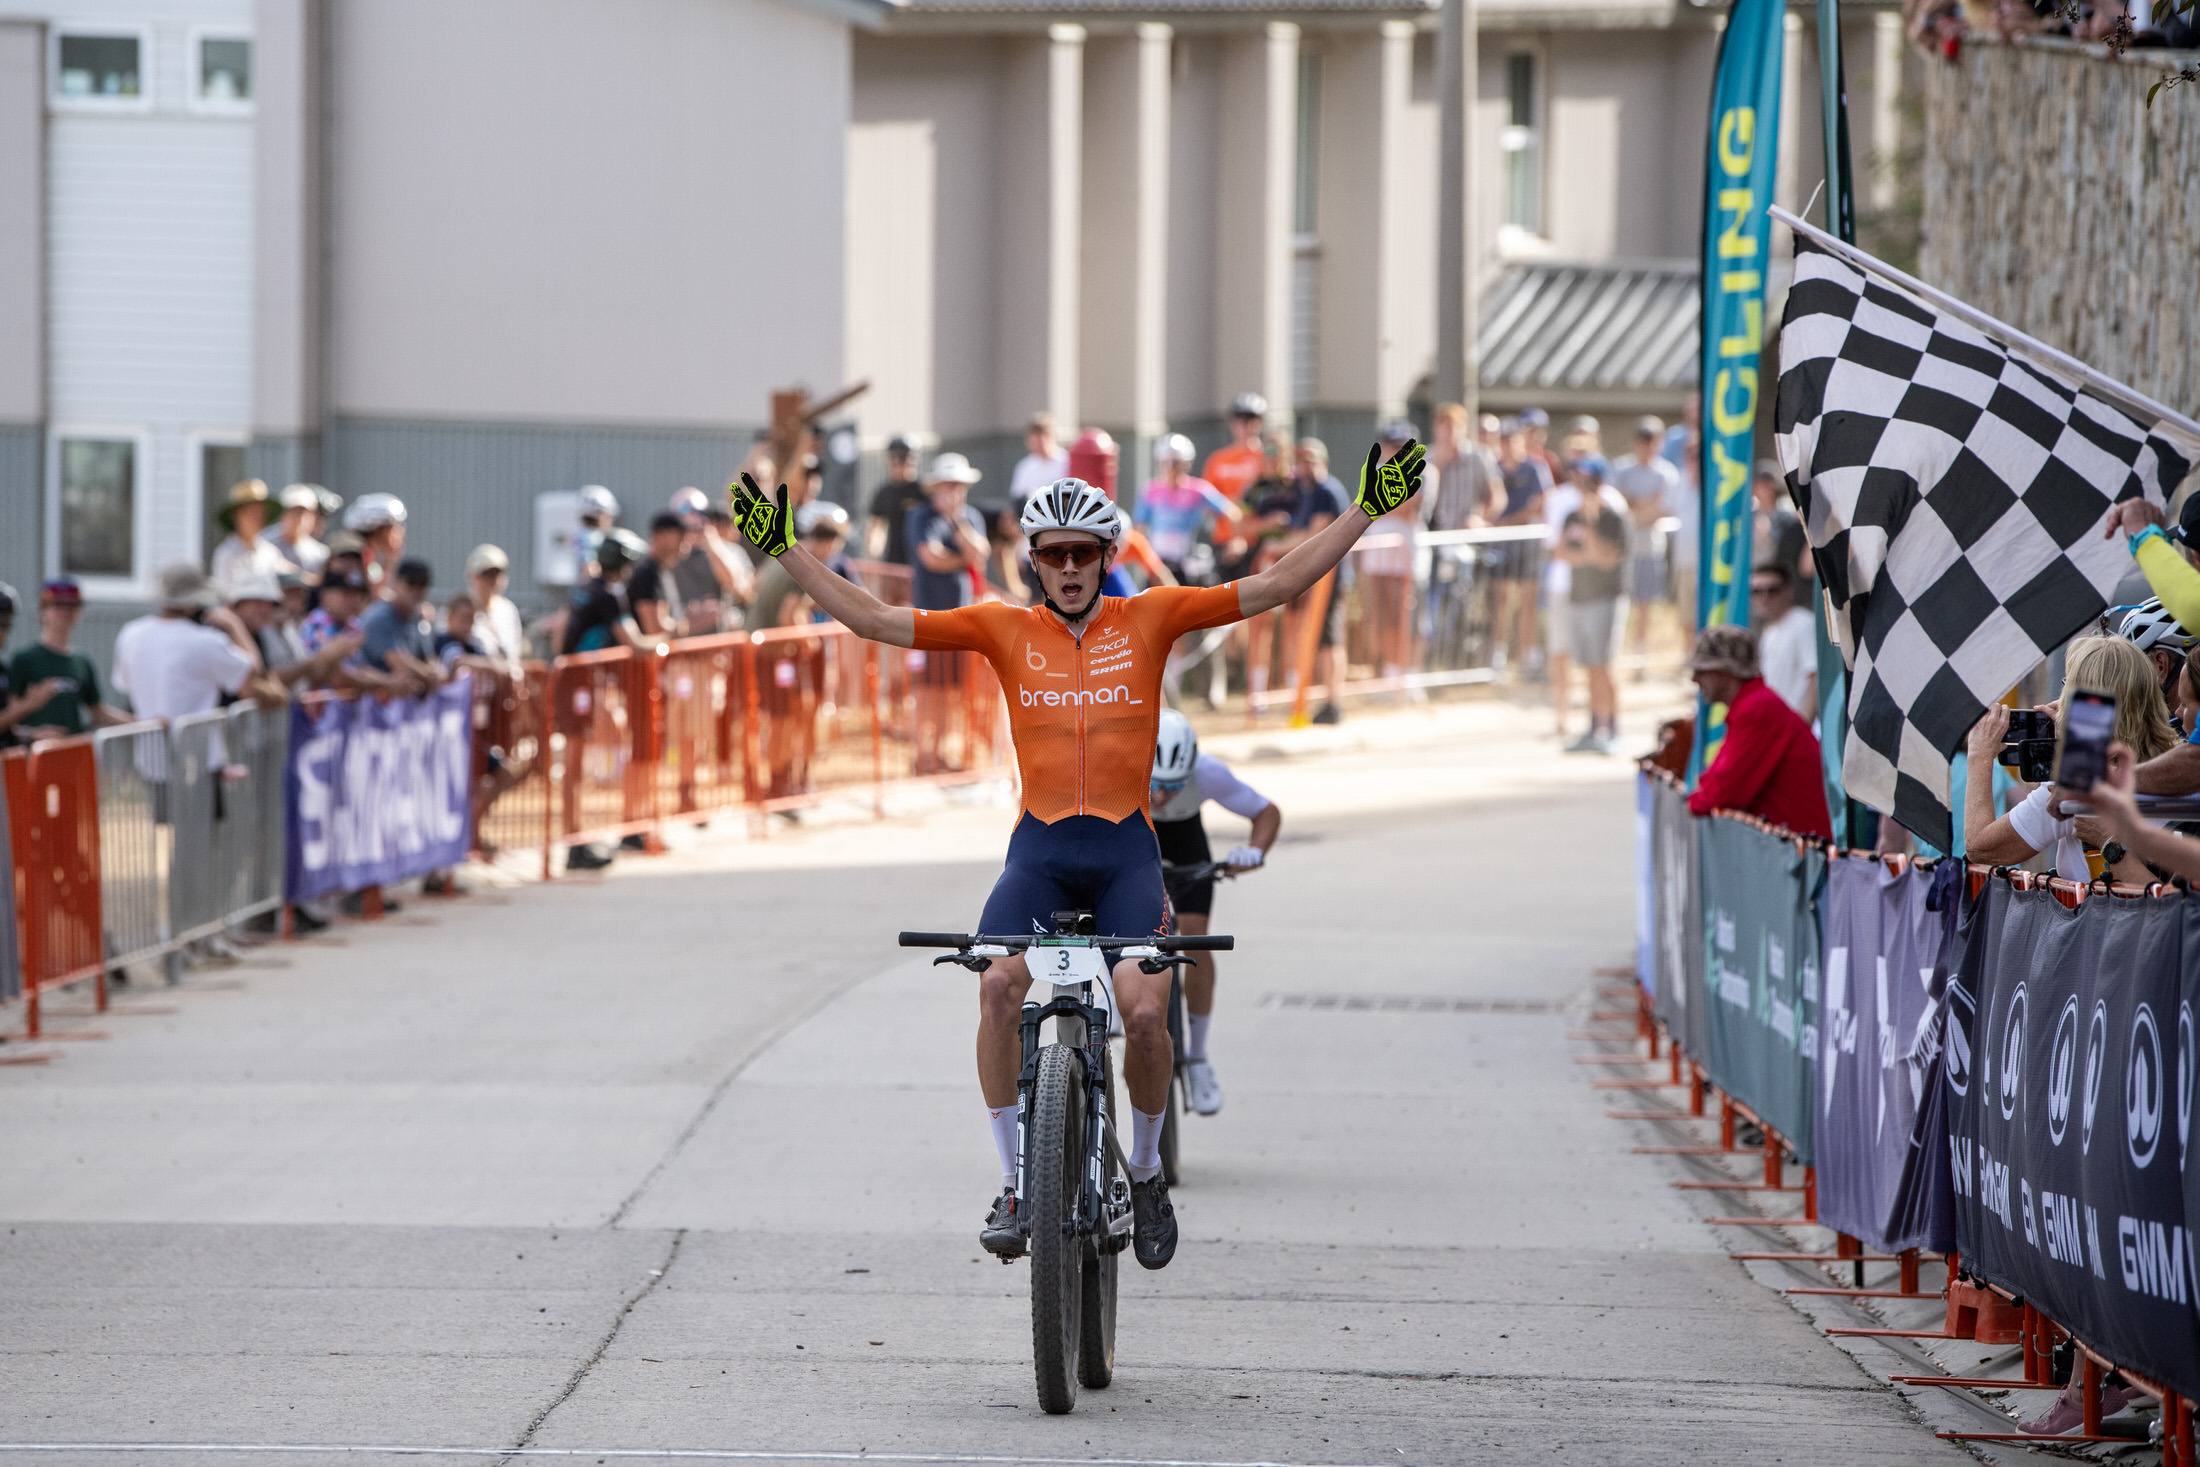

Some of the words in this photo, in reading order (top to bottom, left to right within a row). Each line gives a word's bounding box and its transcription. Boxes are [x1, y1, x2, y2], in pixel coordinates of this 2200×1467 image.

[1090, 661, 1132, 675] SRAM
[1058, 949, 1070, 971] 3
[2041, 1191, 2084, 1268] GWM
[2118, 1215, 2187, 1305] GWM
